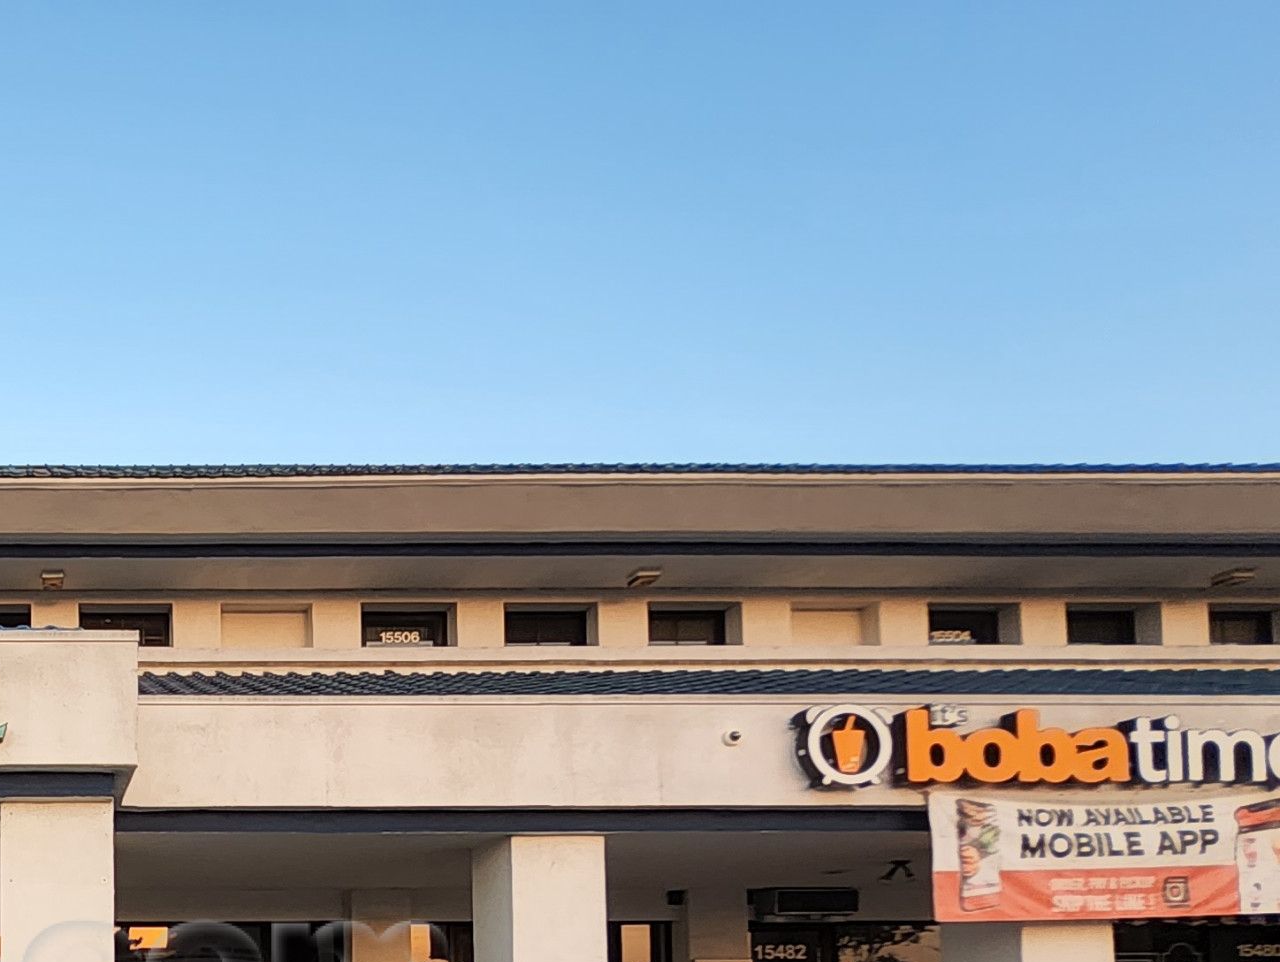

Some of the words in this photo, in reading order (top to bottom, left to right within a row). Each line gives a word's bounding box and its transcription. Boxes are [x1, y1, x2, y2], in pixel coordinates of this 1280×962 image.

[380, 631, 420, 644] 15506
[1017, 807, 1074, 828] NOW
[1082, 804, 1215, 828] AVAILABLE
[1020, 830, 1146, 859] MOBILE
[1156, 828, 1220, 856] APP
[754, 944, 808, 960] 15482
